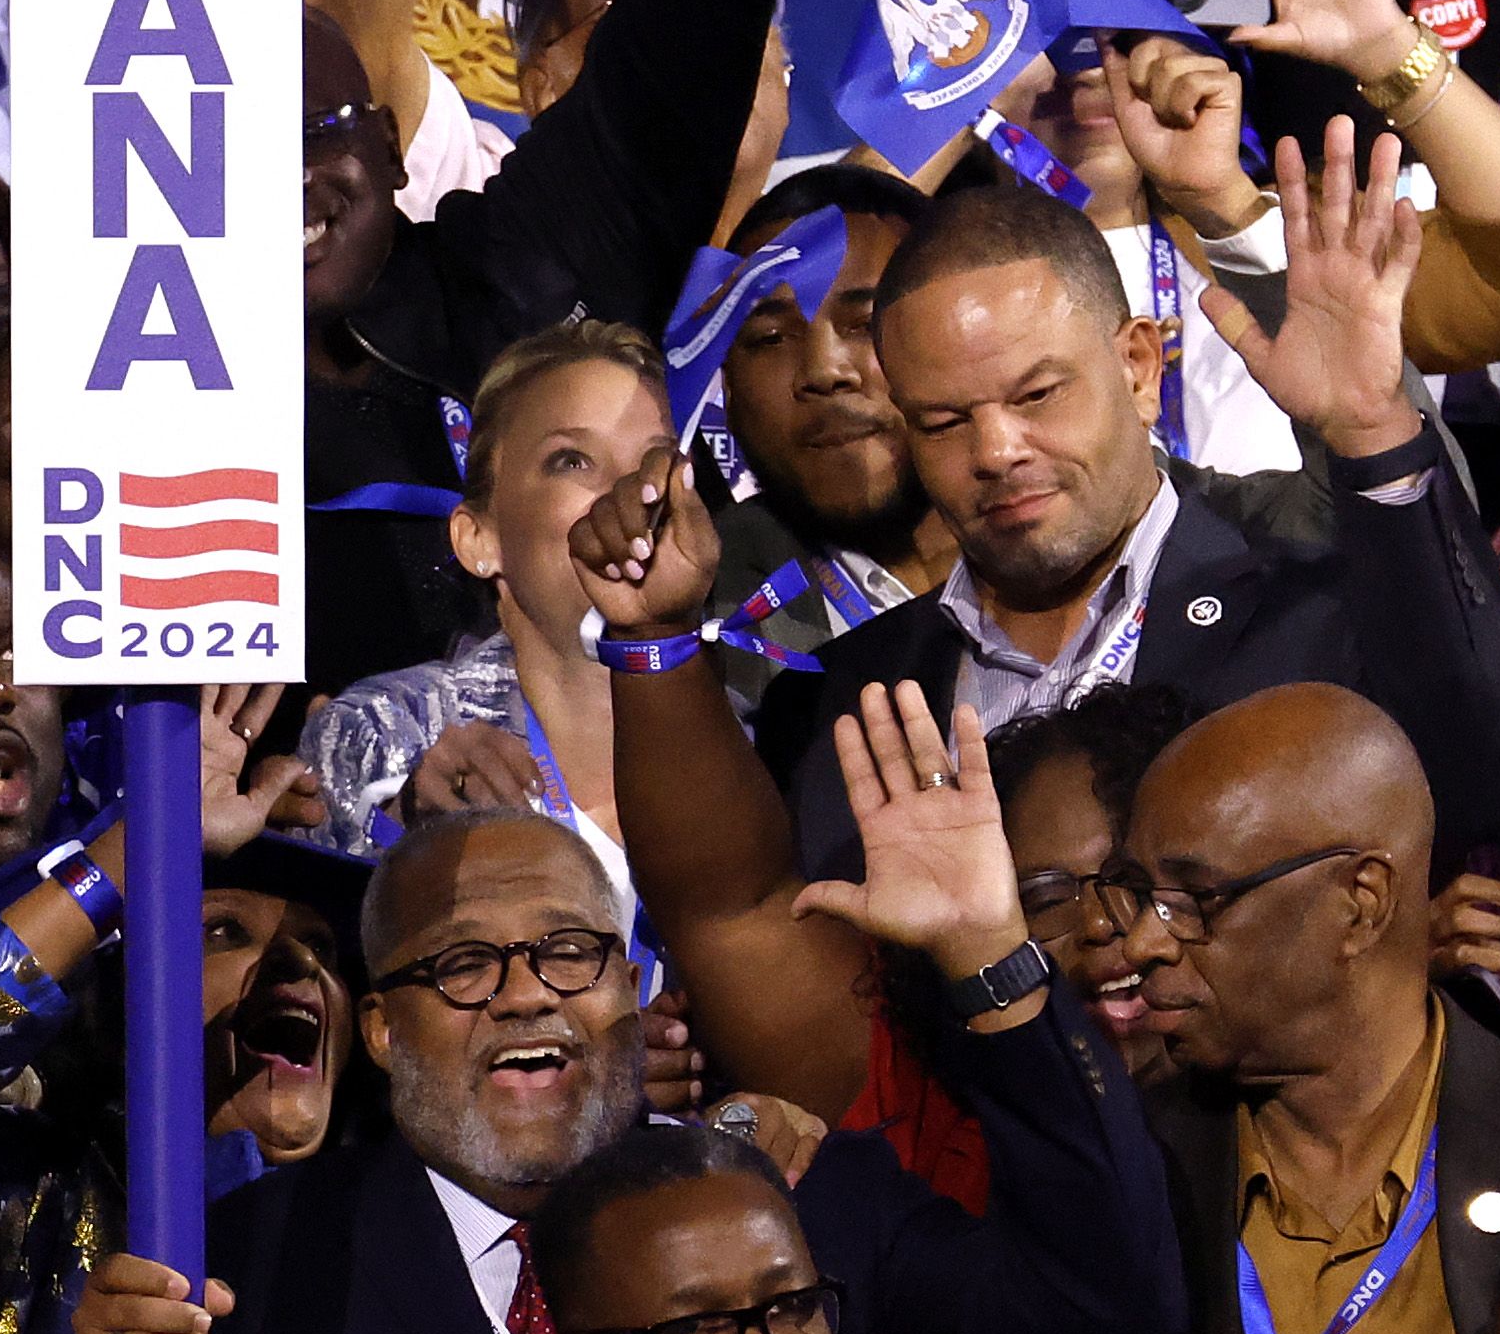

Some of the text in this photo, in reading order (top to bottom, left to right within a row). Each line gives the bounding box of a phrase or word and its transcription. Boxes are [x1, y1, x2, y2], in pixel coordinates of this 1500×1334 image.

[440, 396, 465, 425] NC
[43, 468, 102, 657] DNC
[121, 623, 278, 656] 2024
[1101, 622, 1142, 670] DNC
[74, 870, 100, 897] DNC
[1342, 1269, 1385, 1322] DNC
